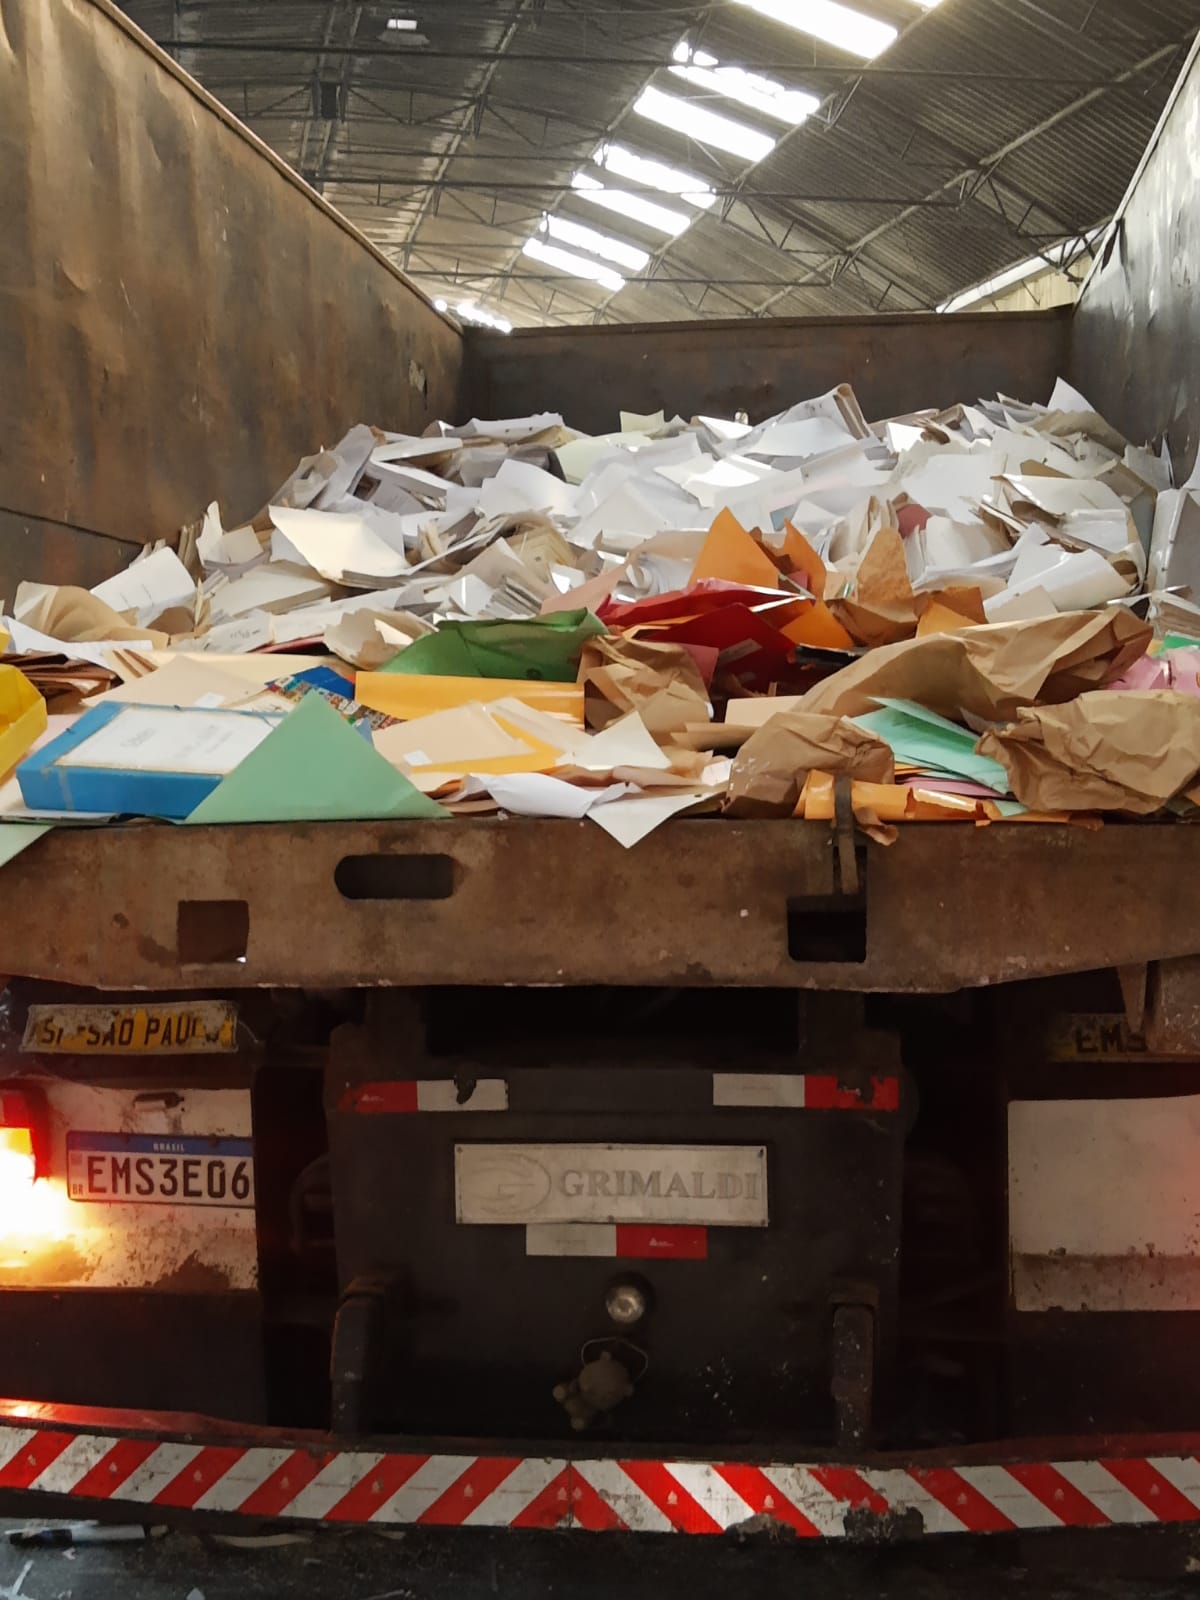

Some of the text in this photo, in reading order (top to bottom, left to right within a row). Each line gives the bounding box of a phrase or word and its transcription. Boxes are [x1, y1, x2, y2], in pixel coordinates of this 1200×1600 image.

[153, 1142, 185, 1152] BRASIL
[87, 1156, 250, 1199] EMS3E06
[560, 1168, 758, 1201] GRIMALDI
